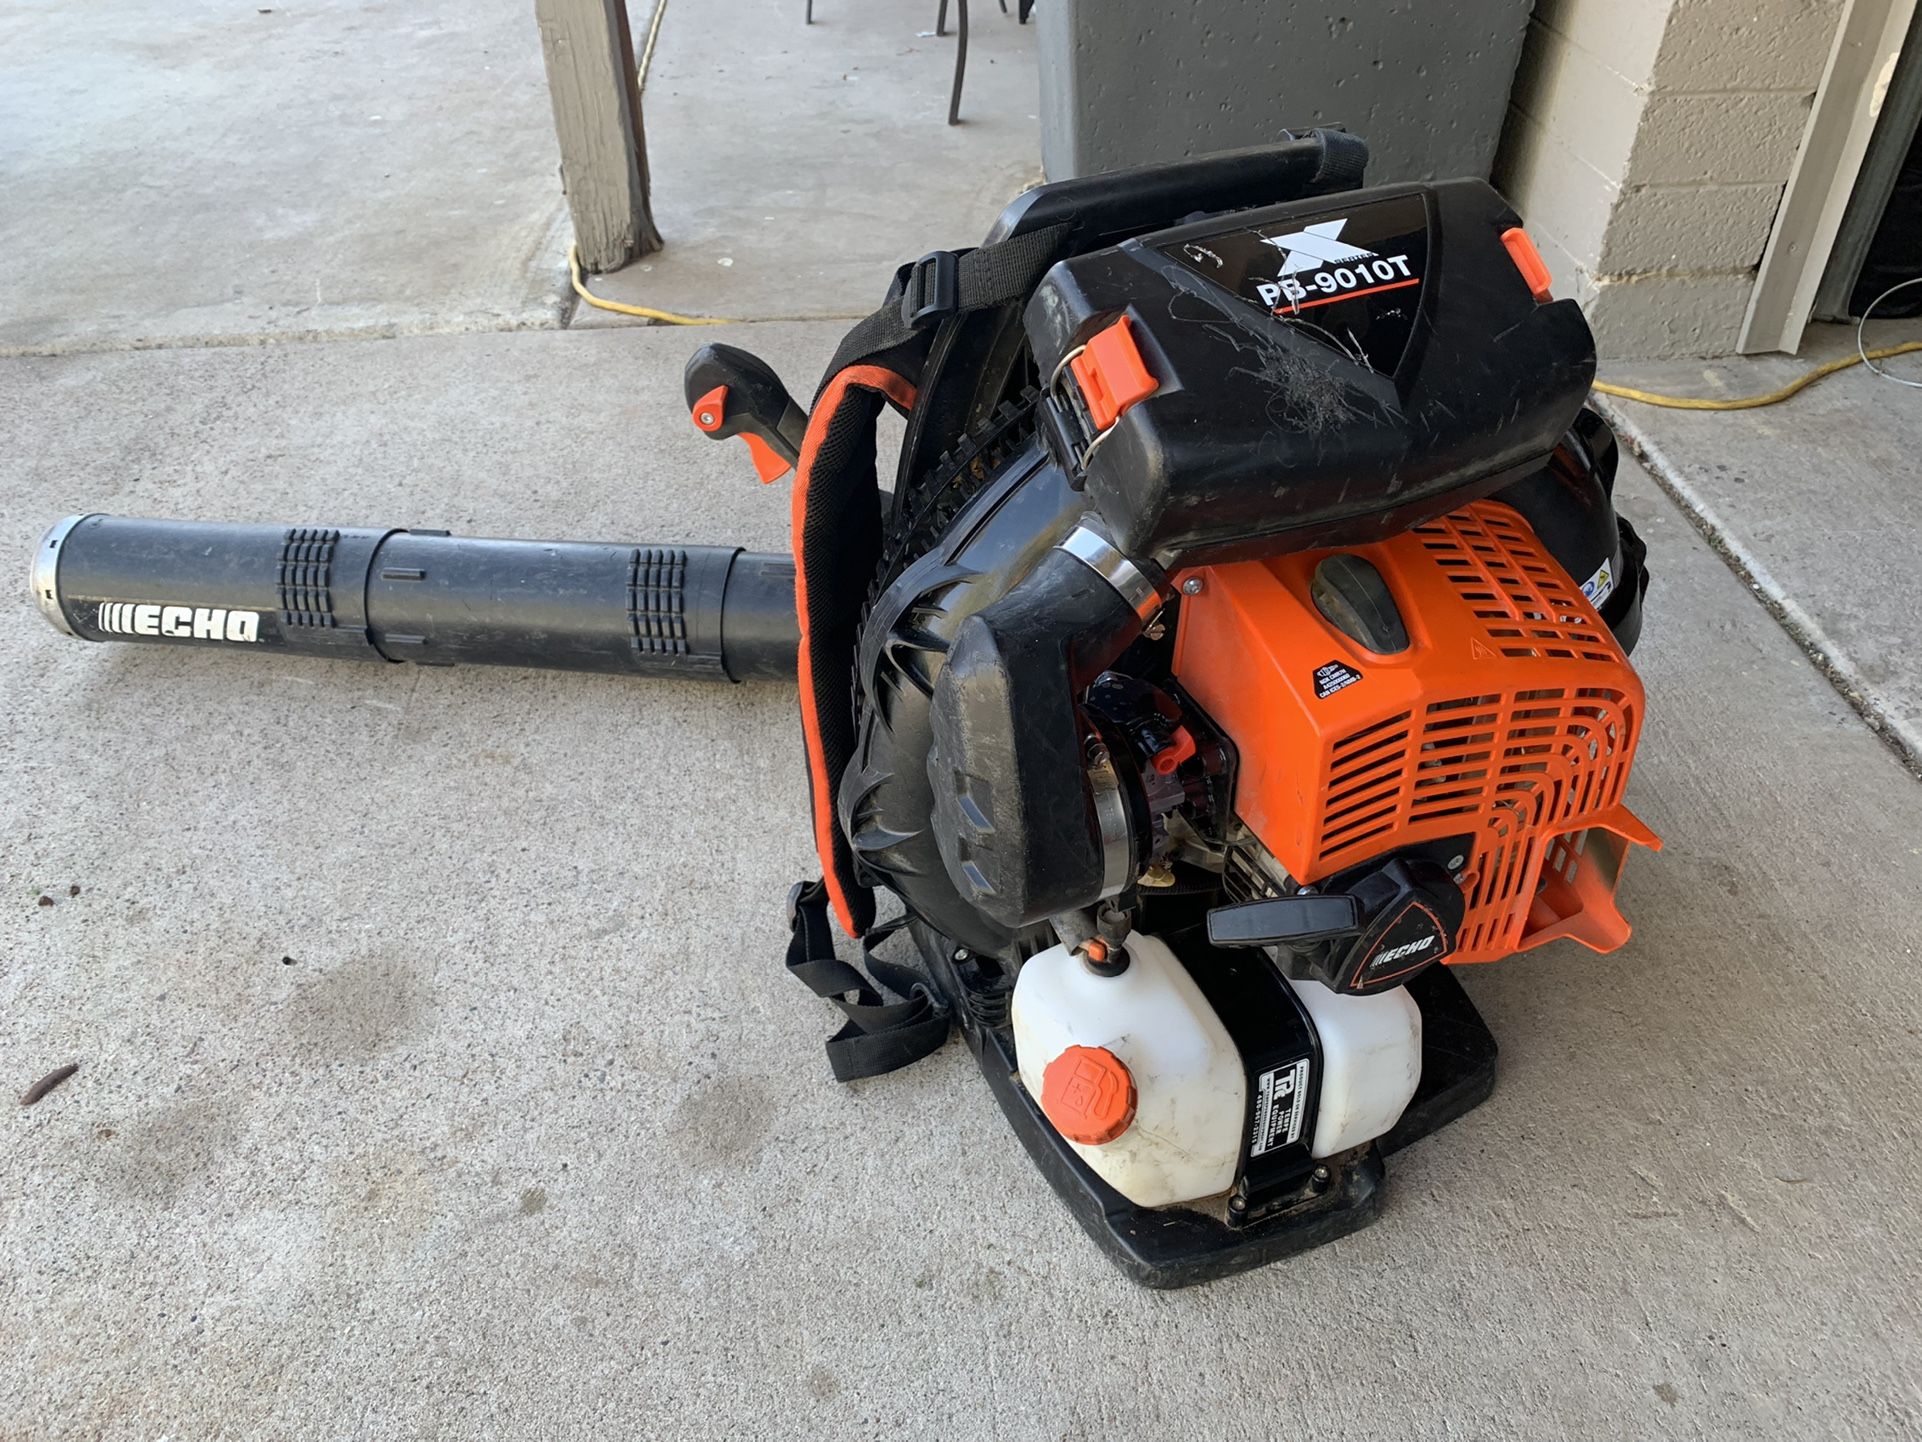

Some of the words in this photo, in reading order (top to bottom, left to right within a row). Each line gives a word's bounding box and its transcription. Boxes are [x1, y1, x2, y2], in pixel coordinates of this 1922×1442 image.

[1256, 255, 1411, 306] PB-9010T
[134, 604, 259, 642] ECHO
[1383, 935, 1435, 963] ECHO
[1268, 1104, 1279, 1146] EQUIPMENT
[1276, 1111, 1285, 1134] POWER
[1282, 1108, 1291, 1133] TEMPE
